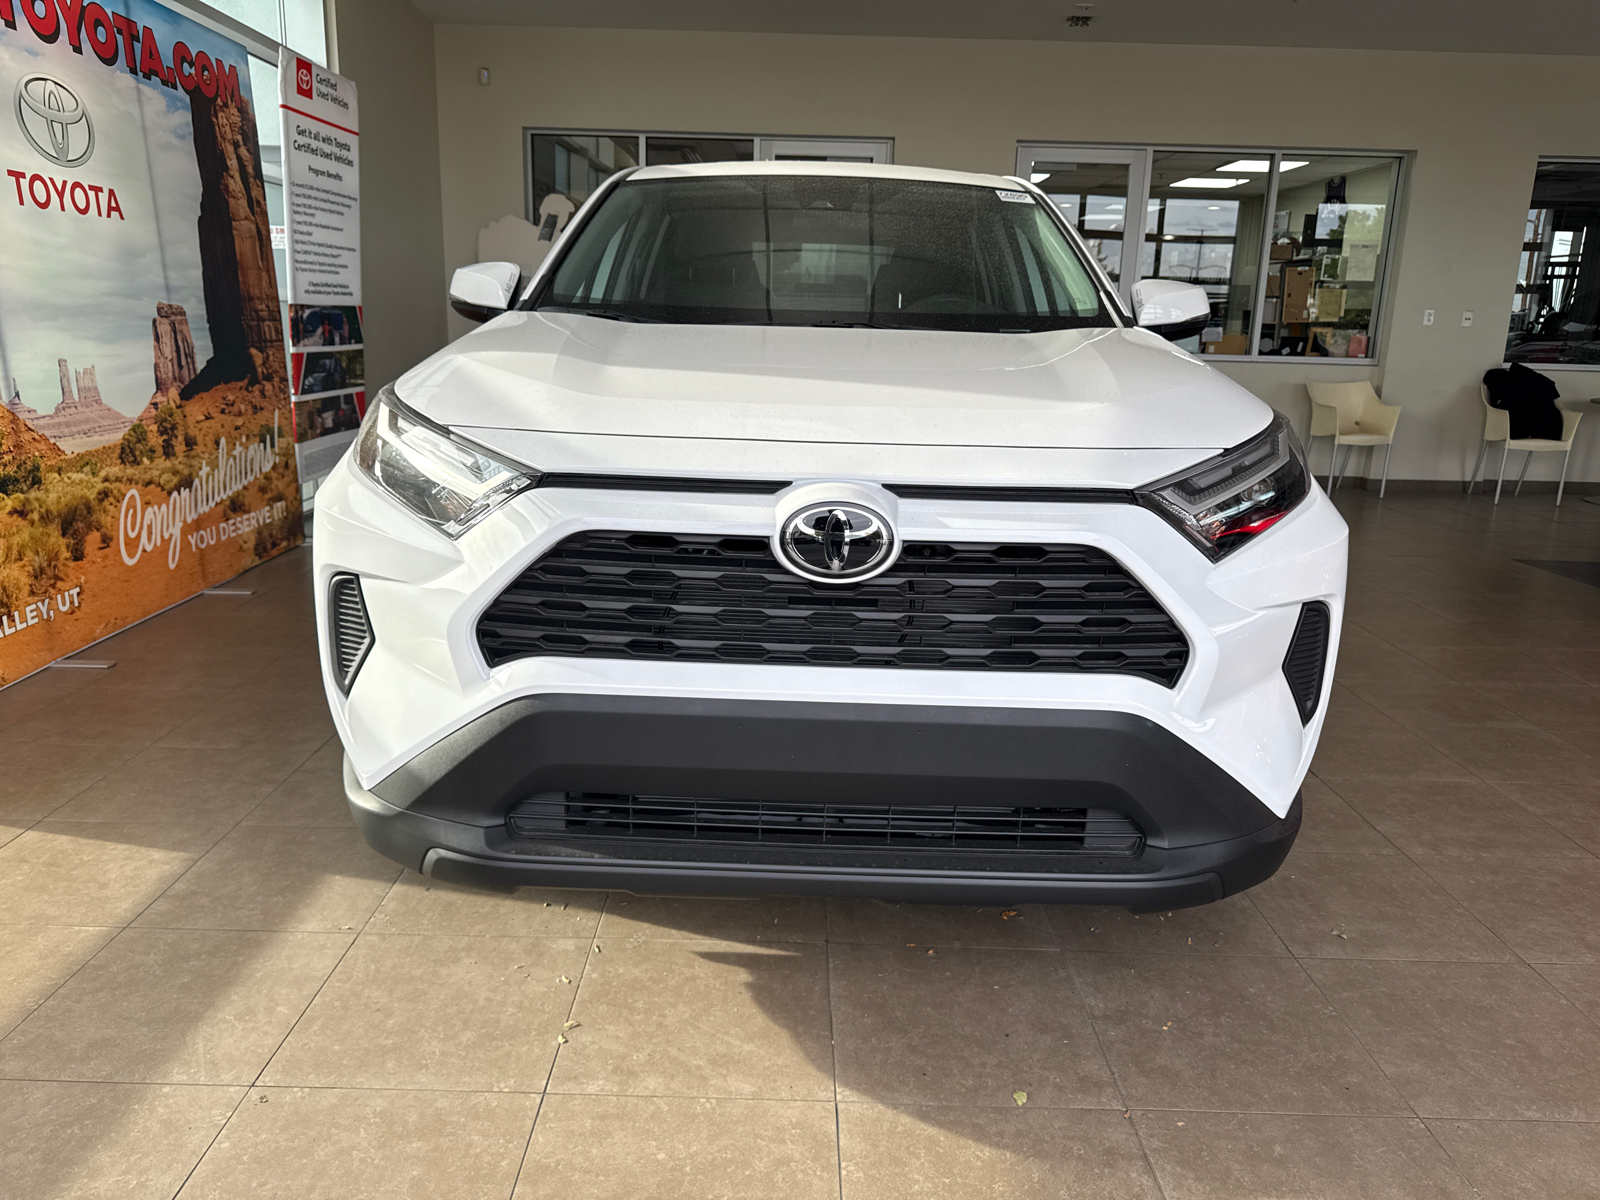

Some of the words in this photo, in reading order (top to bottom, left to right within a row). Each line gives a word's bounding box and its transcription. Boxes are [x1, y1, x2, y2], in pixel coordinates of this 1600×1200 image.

[315, 73, 337, 92] Certified
[316, 87, 330, 101] Used
[330, 94, 349, 110] Vehicles
[293, 139, 319, 157] Certified
[319, 147, 333, 161] Used
[333, 153, 354, 168] Vehicles
[296, 125, 306, 137] Get
[307, 128, 313, 138] it
[321, 133, 334, 146] with
[333, 137, 351, 153] Toyota
[308, 165, 326, 178] Program
[6, 168, 126, 221] TOYOTA
[119, 408, 280, 570] Congratulations!
[188, 526, 217, 552] YOU
[220, 509, 273, 541] DESERVE
[272, 500, 287, 521] IT!
[0, 598, 55, 639] LLEY,
[56, 586, 81, 612] UT
